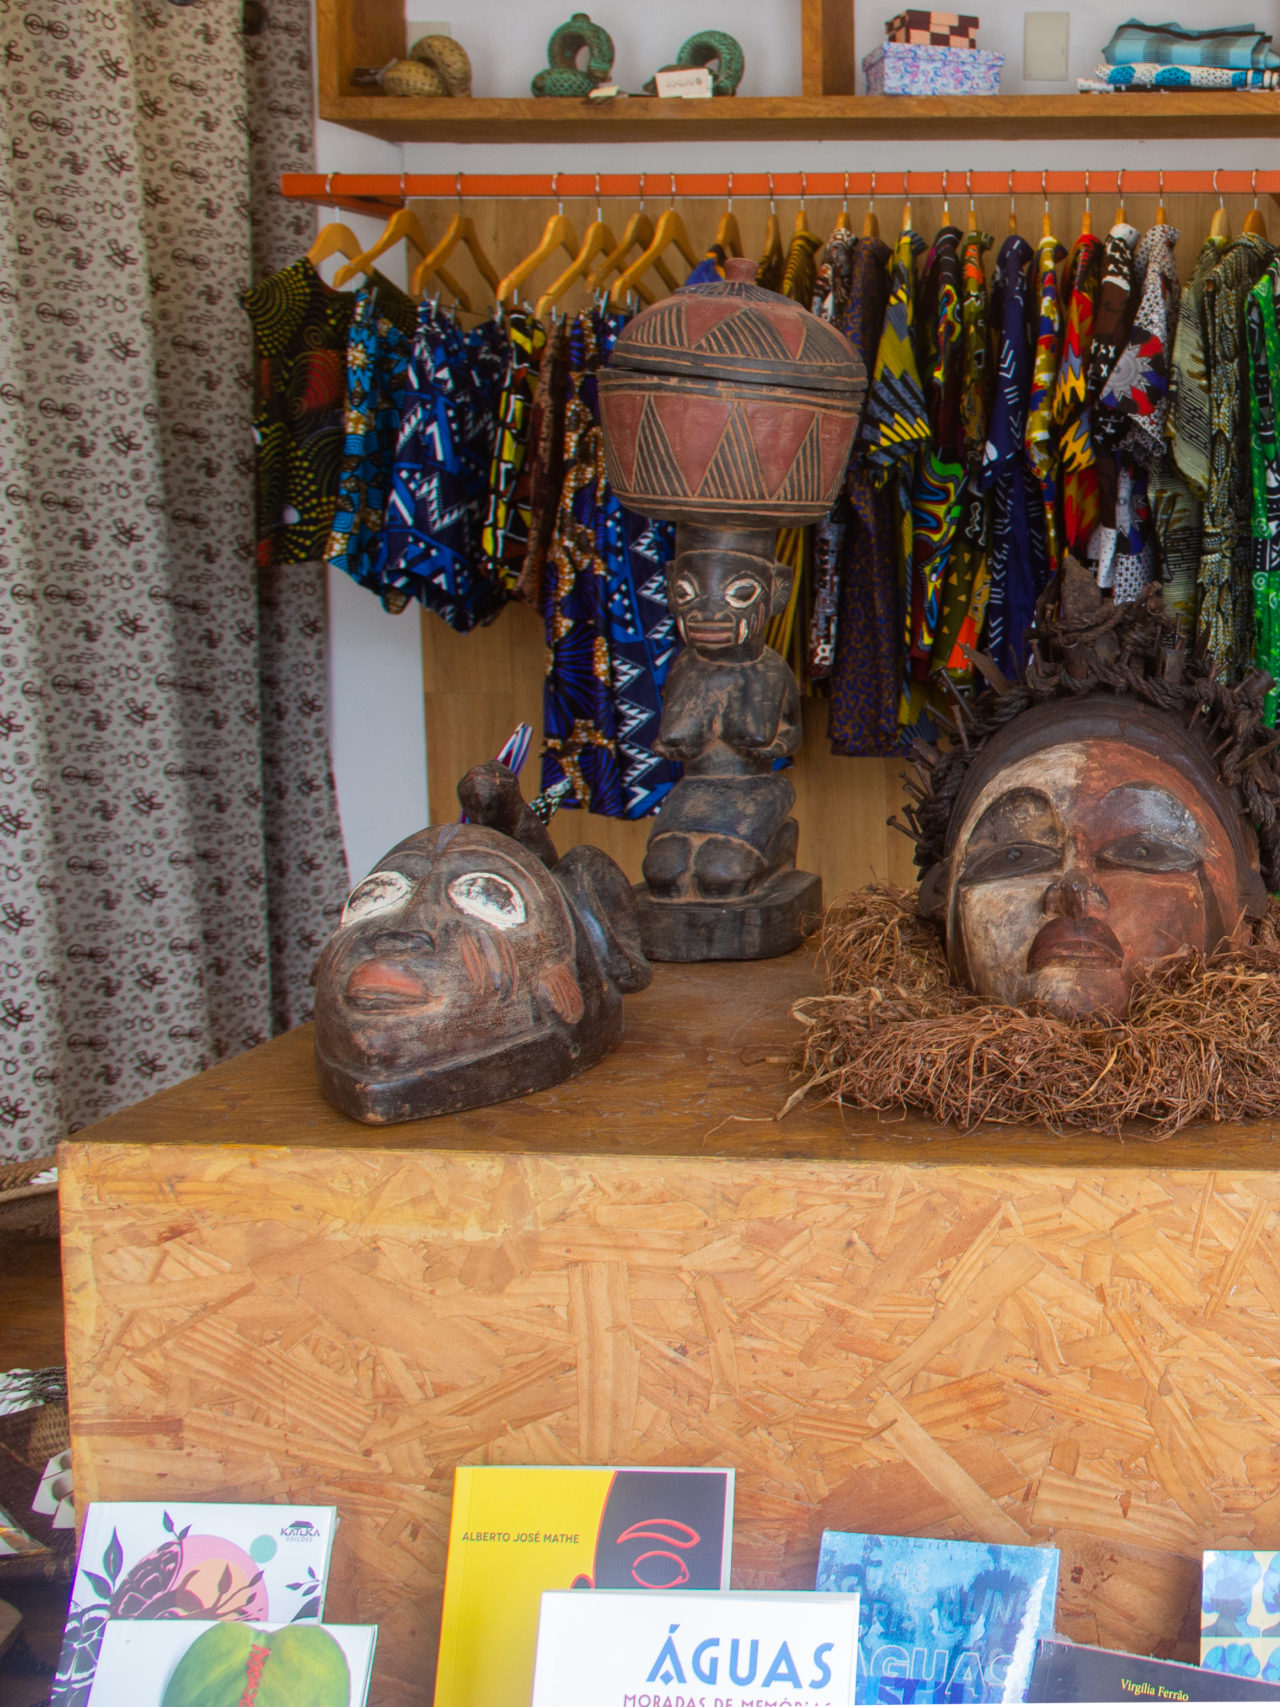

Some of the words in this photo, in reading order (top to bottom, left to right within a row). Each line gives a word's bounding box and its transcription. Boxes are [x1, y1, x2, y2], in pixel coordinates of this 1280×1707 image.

[462, 1531, 511, 1542] ALBERTO
[513, 1531, 541, 1543] JOSÉ
[543, 1533, 580, 1544] MATHE
[645, 1623, 835, 1690] ÁGUAS
[1121, 1678, 1155, 1696] Virgília
[1157, 1685, 1189, 1701] Ferrão
